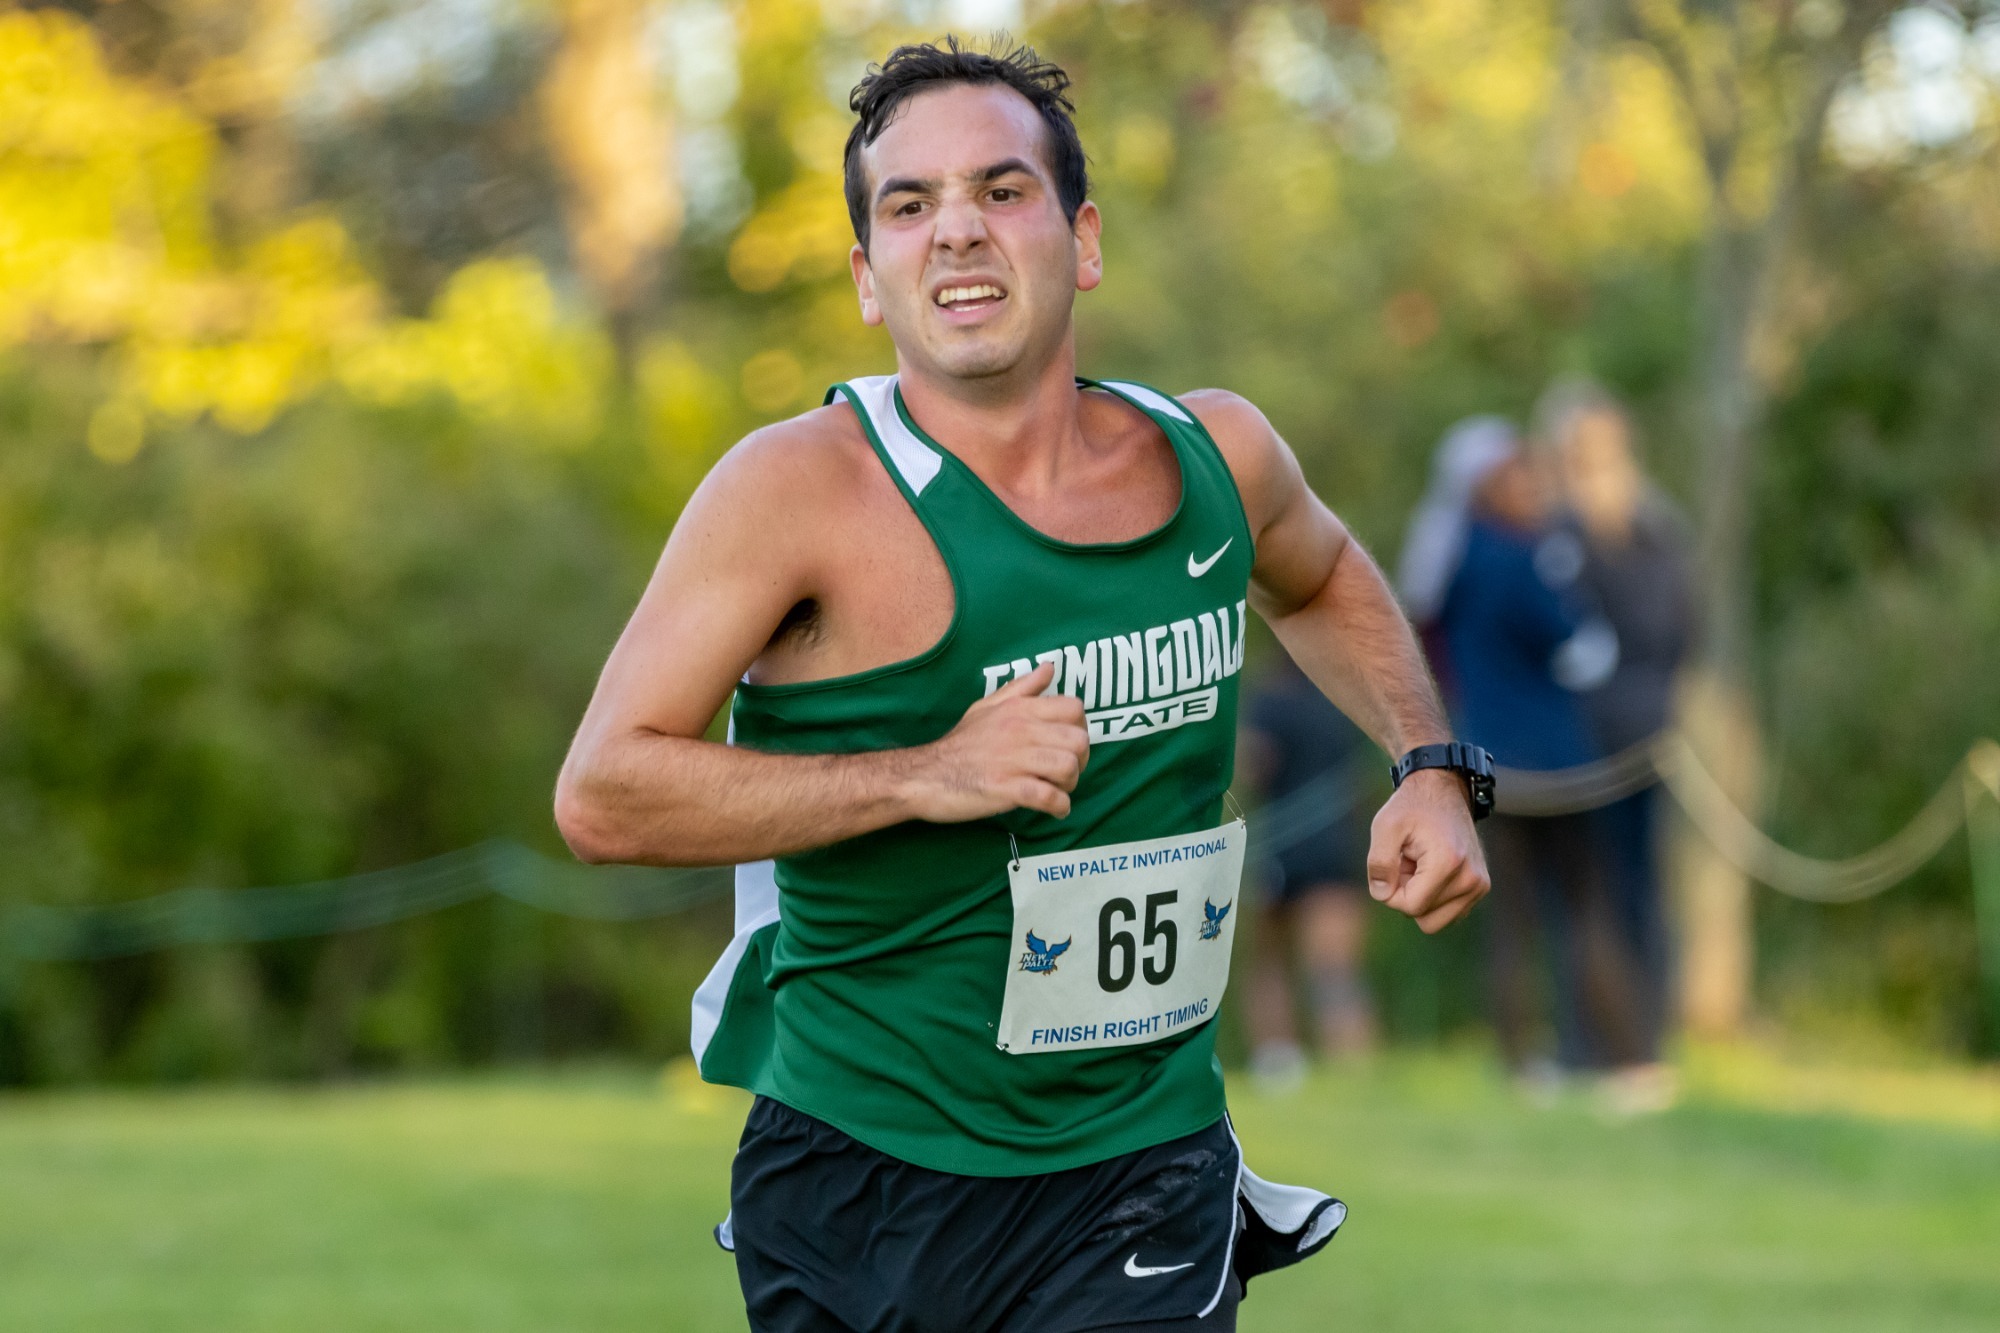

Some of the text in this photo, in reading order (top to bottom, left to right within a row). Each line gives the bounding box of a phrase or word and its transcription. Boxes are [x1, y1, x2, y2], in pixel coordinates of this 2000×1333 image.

[1090, 696, 1210, 735] TATE
[1038, 837, 1228, 883] NEW PALTZ INVITATIONAL
[1022, 953, 1047, 962] NEW
[1097, 889, 1178, 993] 65
[1022, 958, 1054, 970] PALTZ
[1031, 998, 1208, 1045] FINISH RIGHT TIMING
